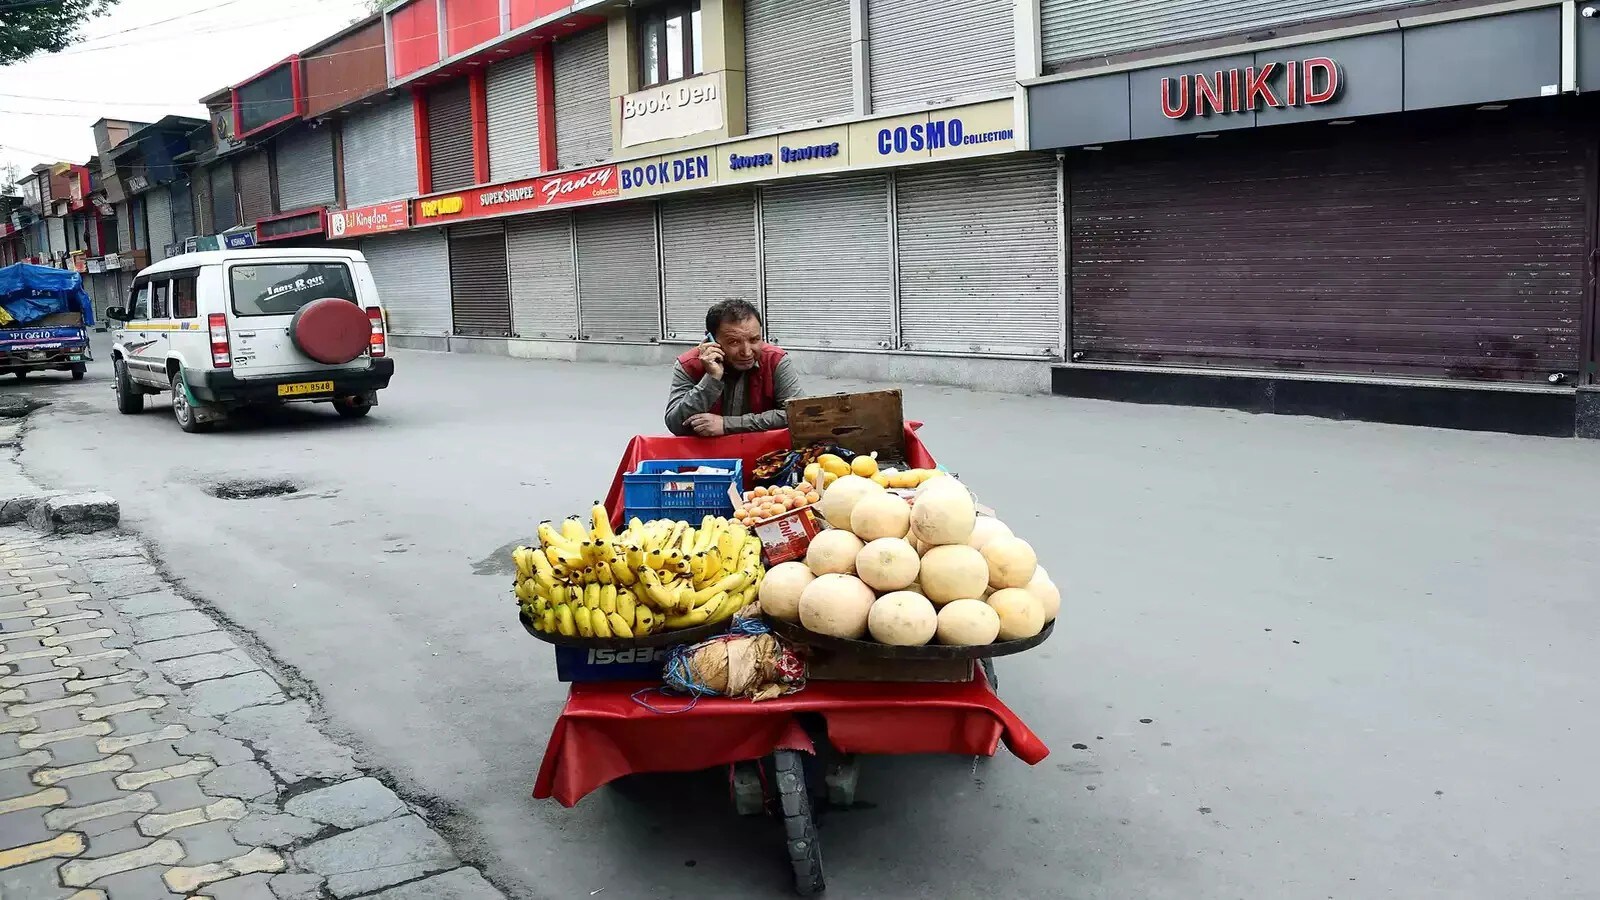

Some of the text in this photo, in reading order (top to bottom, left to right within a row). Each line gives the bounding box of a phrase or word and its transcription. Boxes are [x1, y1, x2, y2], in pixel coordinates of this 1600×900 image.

[624, 84, 717, 119] Book Den
[1161, 57, 1343, 119] UNIKID
[878, 119, 1014, 155] COSMO COLLECTION
[542, 168, 613, 204] Fancy
[621, 155, 709, 189] BOOK DEN
[480, 186, 534, 206] SUPER SHOPEE
